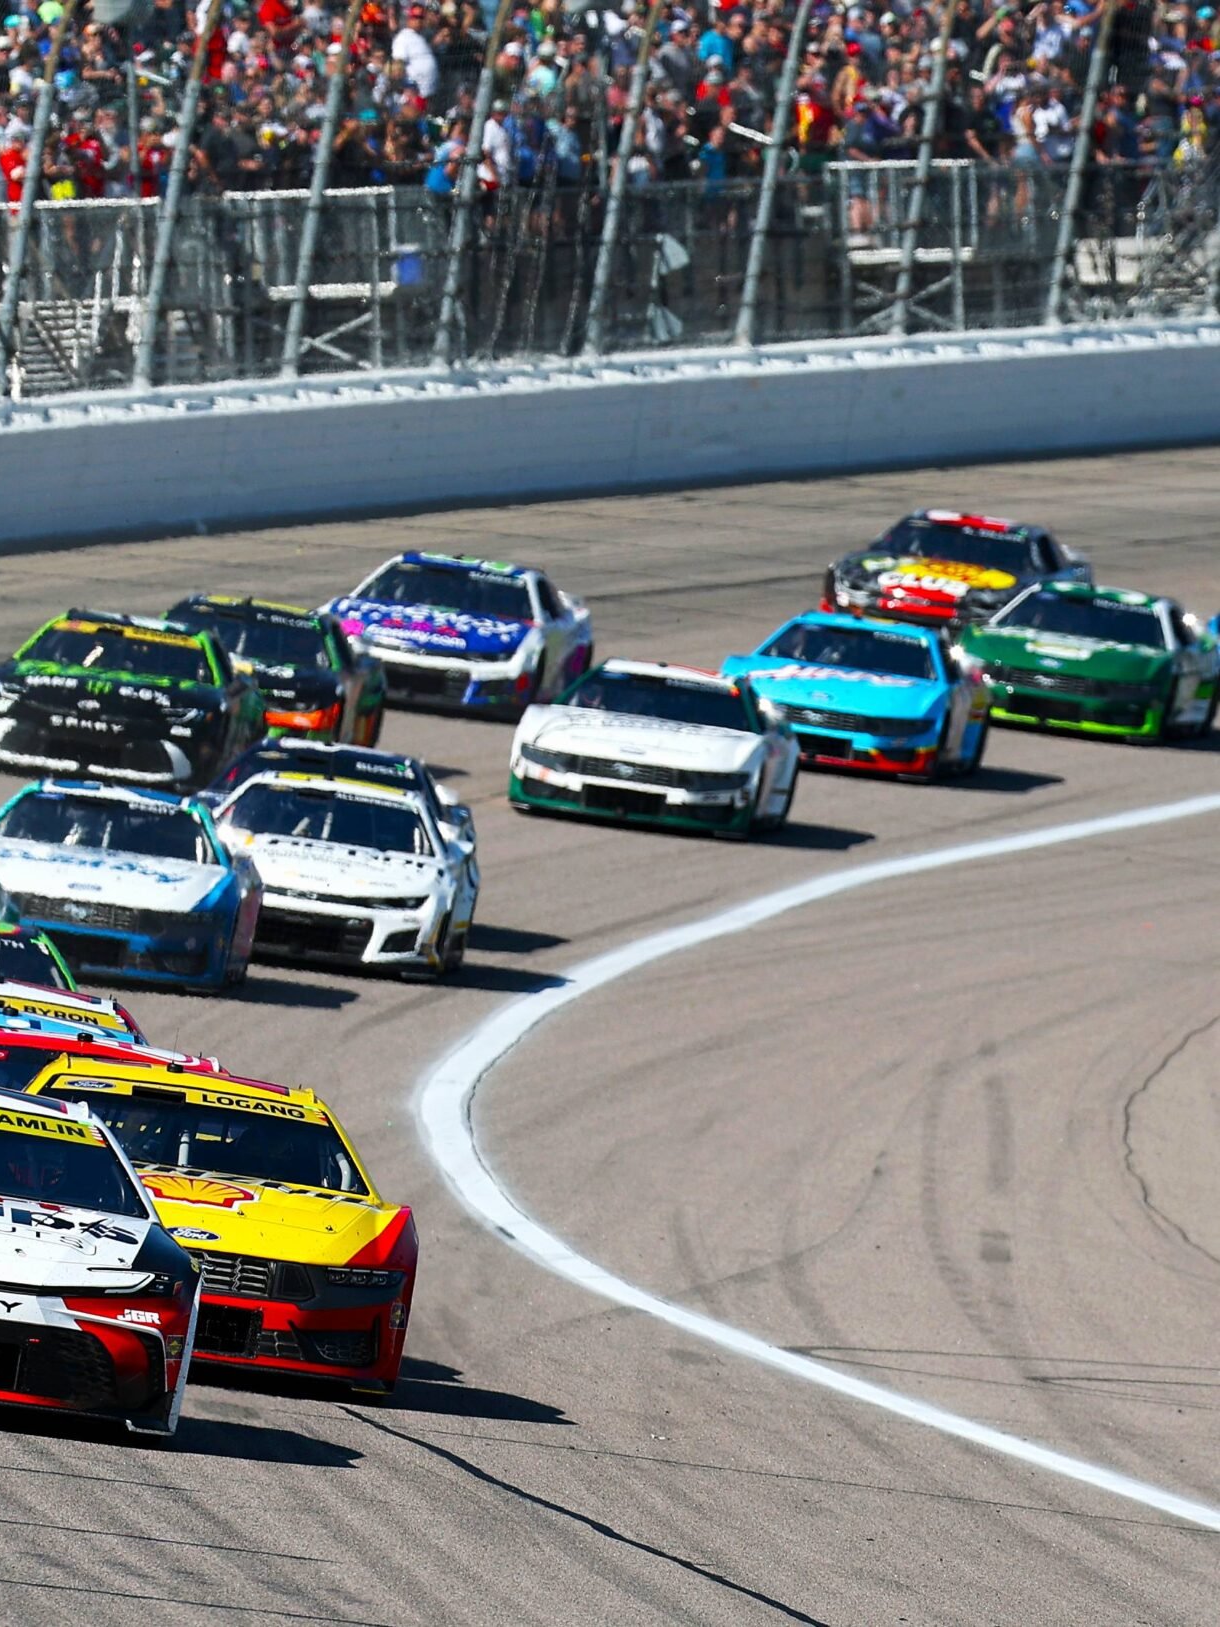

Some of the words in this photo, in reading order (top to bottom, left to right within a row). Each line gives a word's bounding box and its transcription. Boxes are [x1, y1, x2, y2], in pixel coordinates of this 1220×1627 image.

[22, 1005, 98, 1025] BYRON
[202, 1093, 306, 1119] LOGANO
[116, 1308, 162, 1325] JGR
